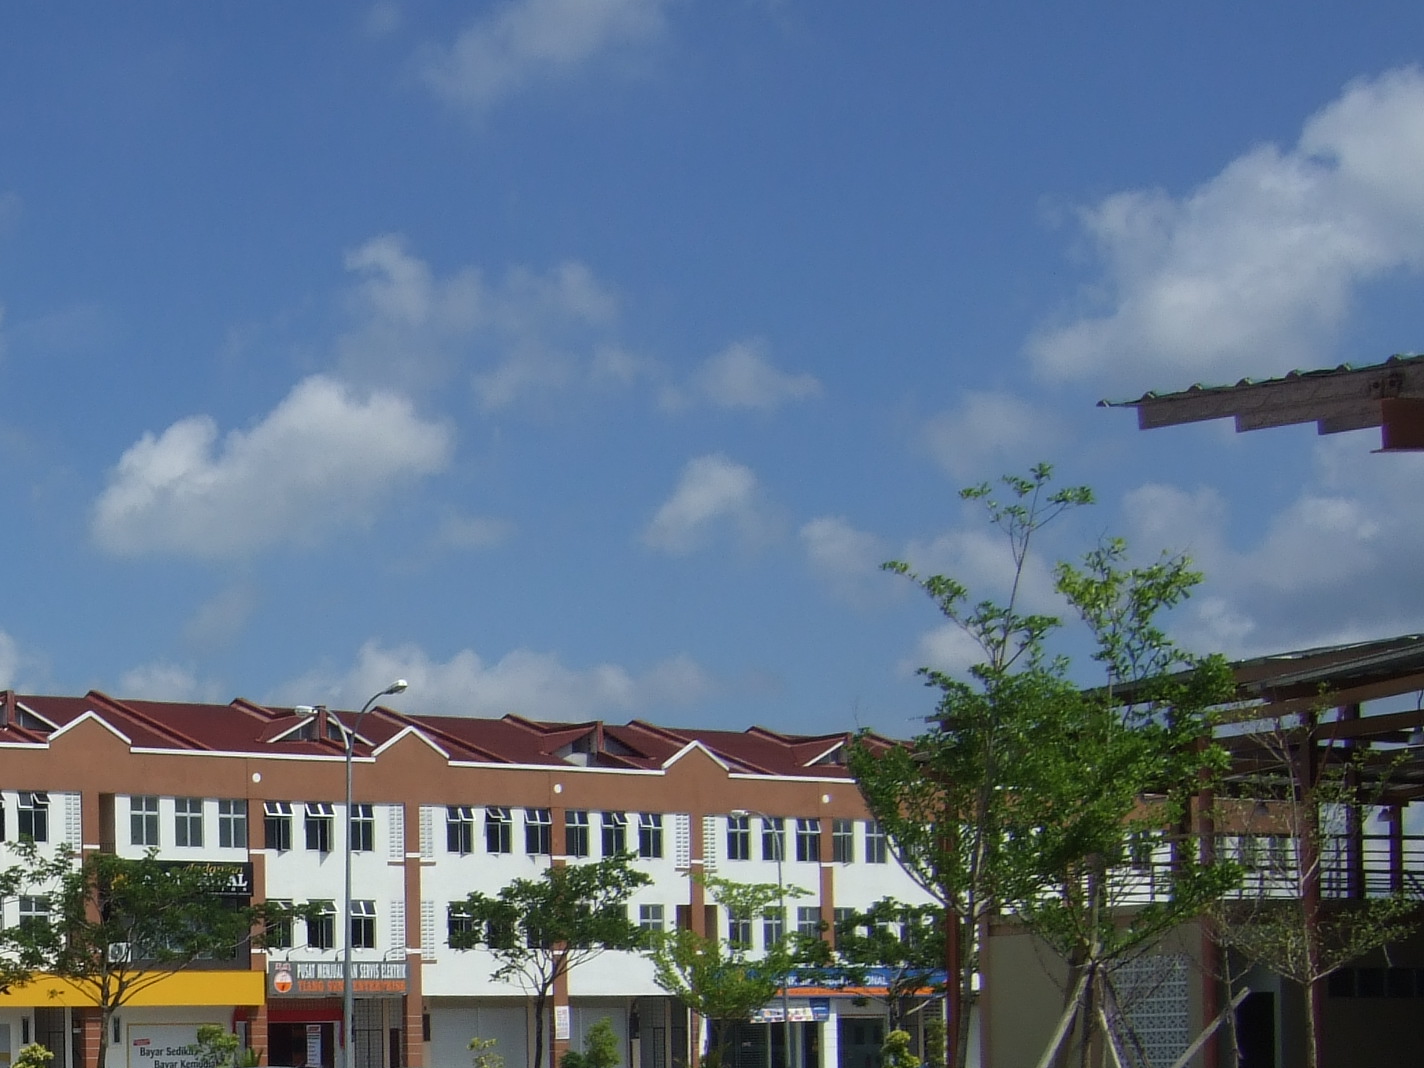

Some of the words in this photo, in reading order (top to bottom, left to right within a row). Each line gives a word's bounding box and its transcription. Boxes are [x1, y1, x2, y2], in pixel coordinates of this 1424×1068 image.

[297, 964, 316, 979] PUSAT
[360, 964, 379, 979] SERVIS
[381, 964, 406, 979] ELEKTRIK
[139, 1047, 164, 1059] Bayar
